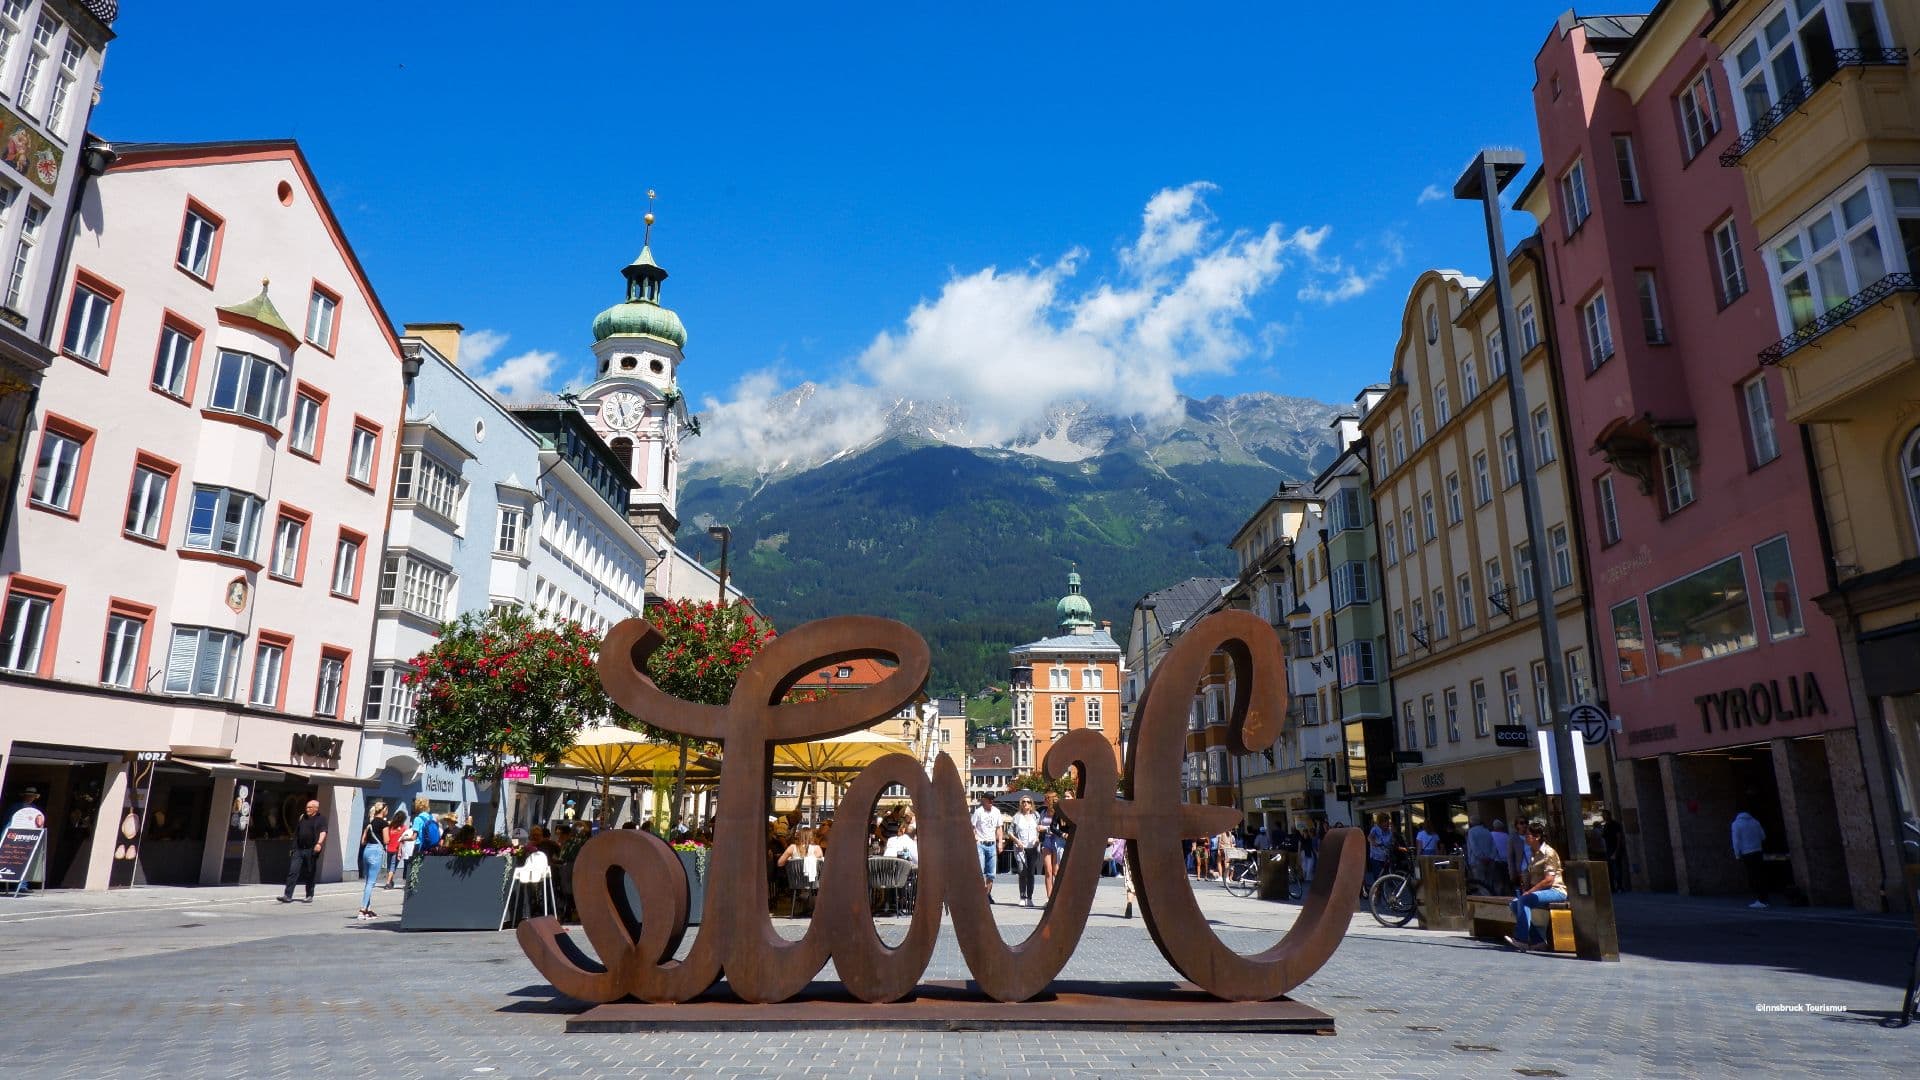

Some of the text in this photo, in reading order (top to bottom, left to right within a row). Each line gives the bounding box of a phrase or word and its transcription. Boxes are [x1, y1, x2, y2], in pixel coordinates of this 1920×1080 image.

[1694, 671, 1829, 734] TYROLIA
[1498, 732, 1525, 740] ecco
[137, 751, 167, 761] NORZ
[291, 732, 344, 761] NORZ
